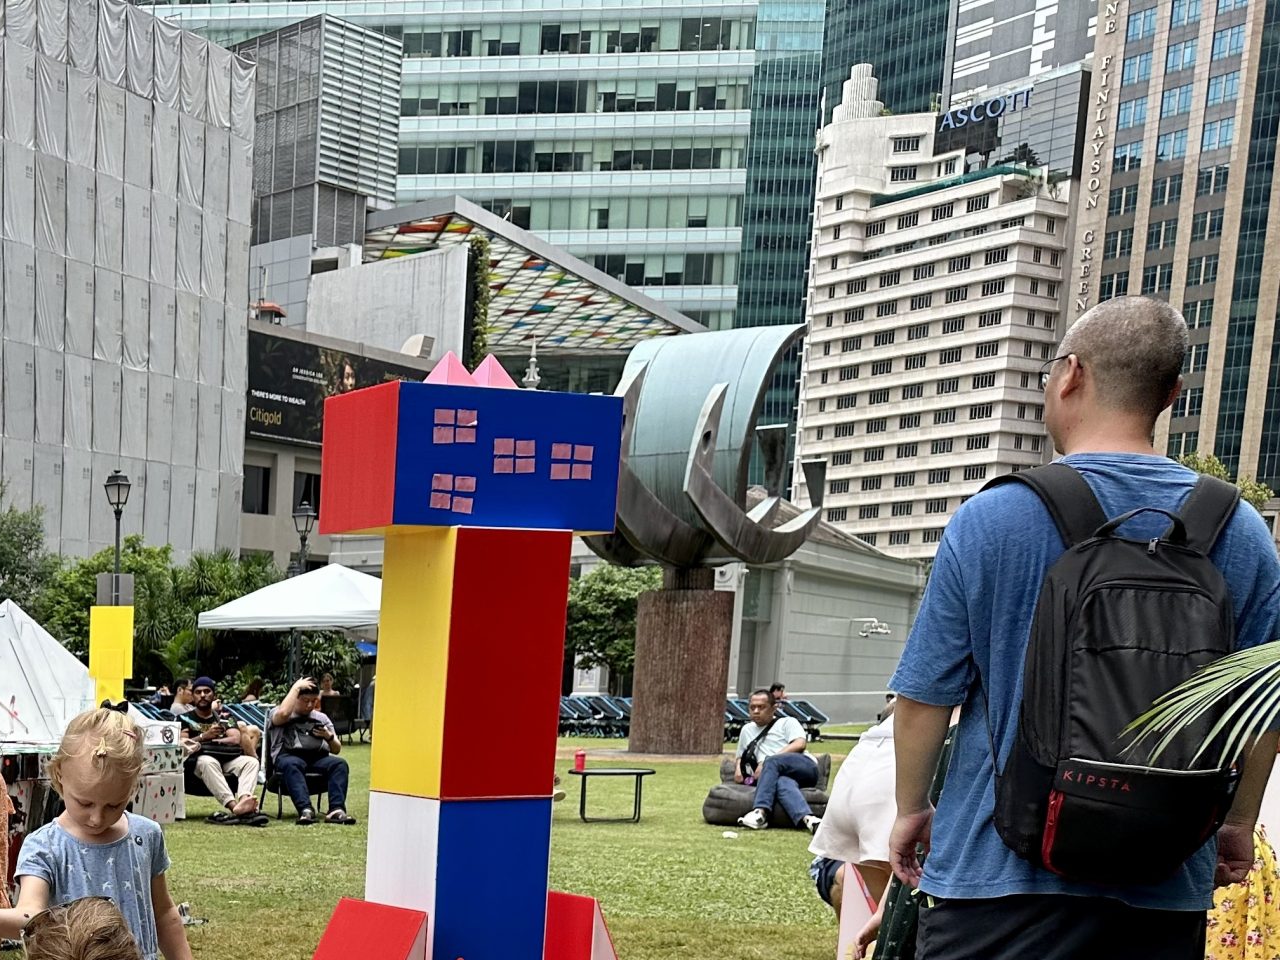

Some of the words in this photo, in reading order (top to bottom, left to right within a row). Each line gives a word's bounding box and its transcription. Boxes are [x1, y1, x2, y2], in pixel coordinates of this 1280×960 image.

[939, 87, 1034, 132] ASCOTT
[1086, 55, 1113, 210] FINLAYSON
[1076, 230, 1095, 312] GREEN
[269, 393, 282, 401] MORE
[250, 407, 282, 426] Citigold
[1062, 769, 1131, 792] KIPSTA
